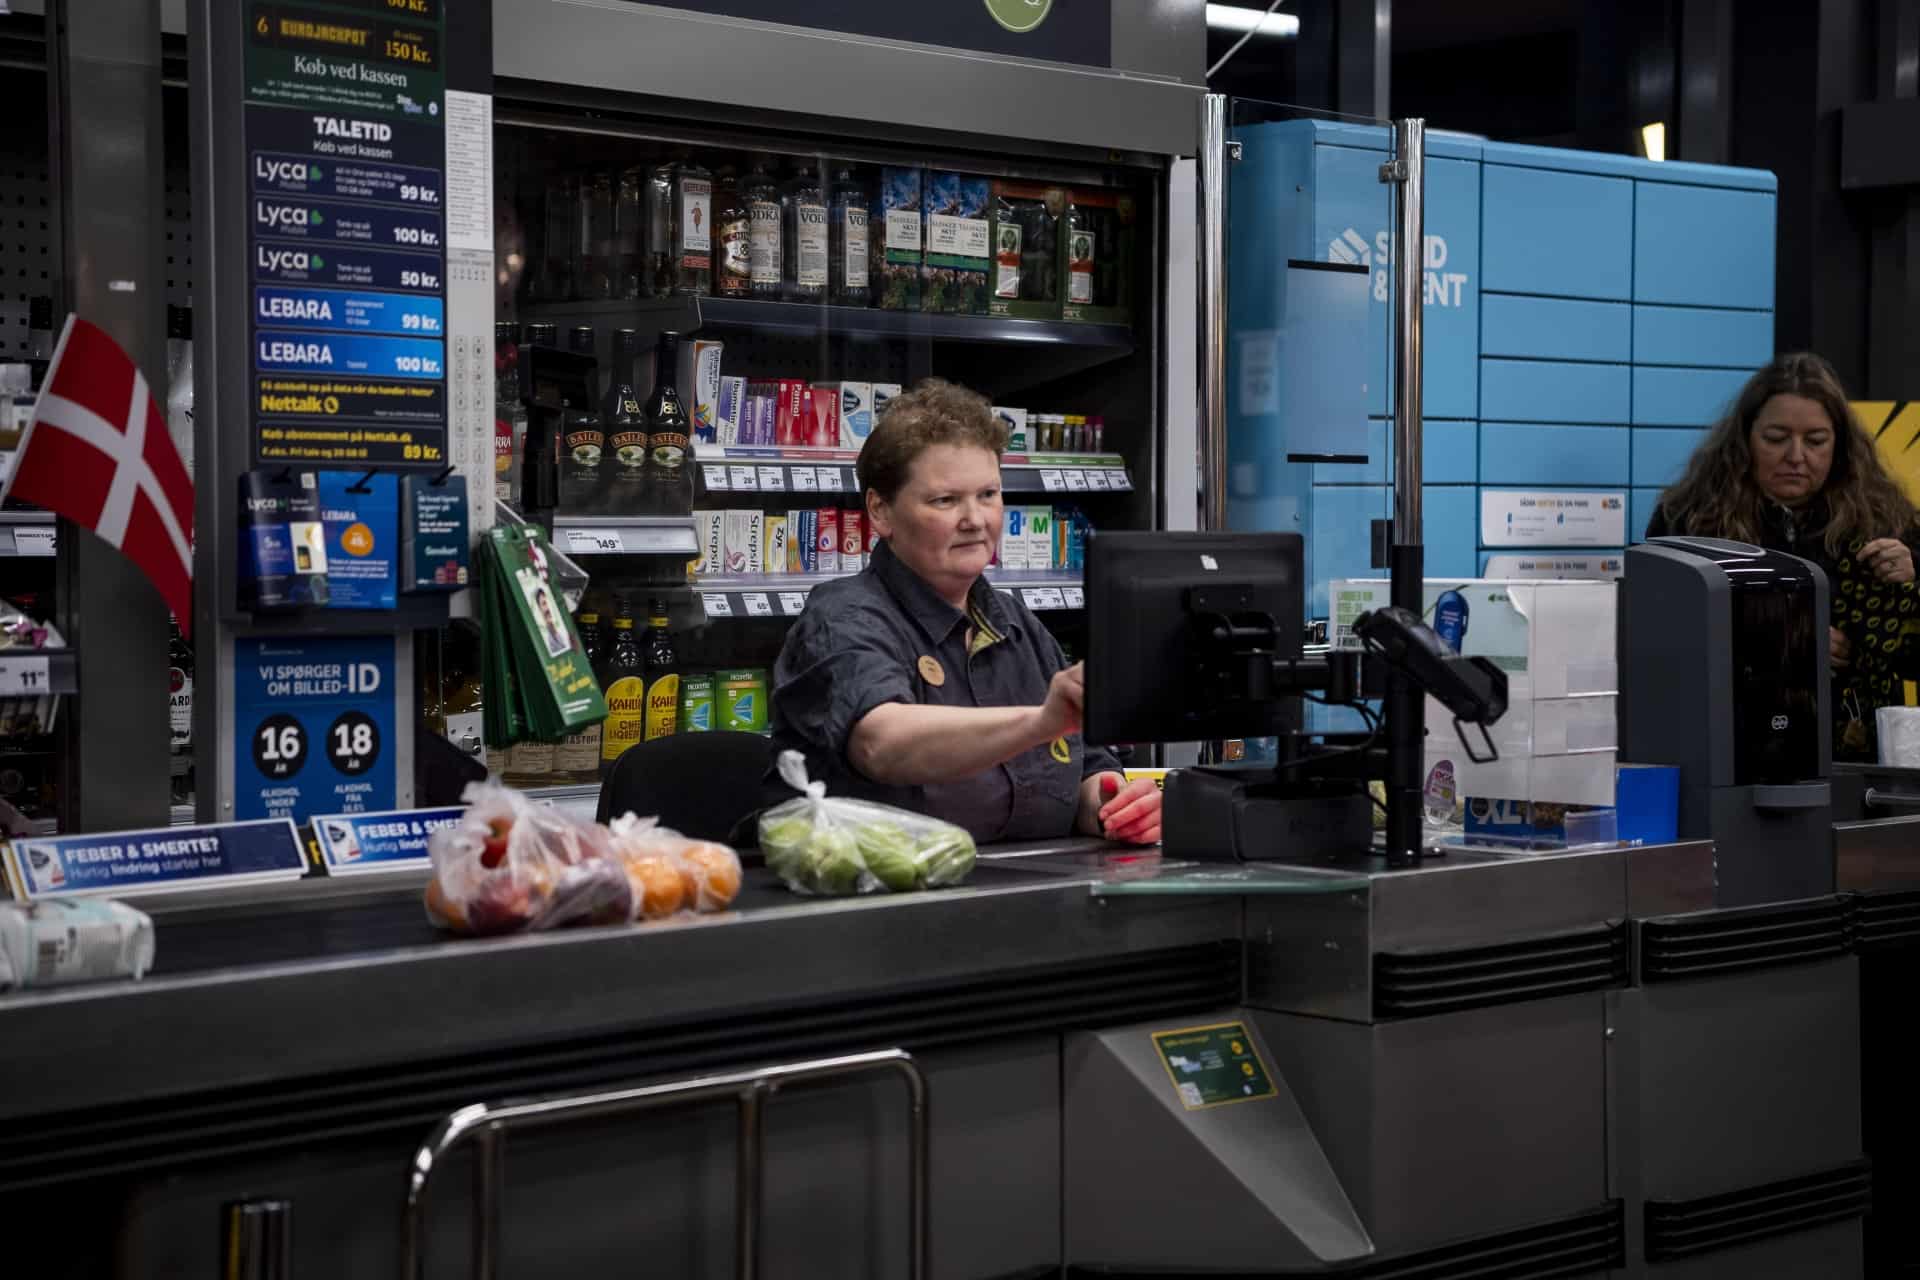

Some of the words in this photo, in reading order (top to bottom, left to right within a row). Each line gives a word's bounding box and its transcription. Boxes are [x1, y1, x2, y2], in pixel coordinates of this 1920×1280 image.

[257, 17, 269, 33] 6
[385, 40, 410, 59] 150
[412, 44, 431, 63] kr.
[294, 56, 327, 76] Køb
[329, 59, 357, 80] ved
[360, 63, 408, 88] kassen
[313, 117, 393, 141] TALETID
[313, 140, 335, 153] Køb
[336, 142, 358, 155] ved
[359, 144, 393, 159] kassen
[255, 156, 308, 184] Lyca
[400, 185, 418, 200] 99
[420, 187, 439, 203] kr.
[257, 202, 309, 229] Lyca
[750, 208, 779, 221] ODKA
[393, 227, 418, 243] 100
[420, 229, 440, 246] kr.
[258, 247, 309, 272] Lyca
[1375, 231, 1448, 269] SD
[401, 271, 419, 287] 50
[421, 271, 440, 288] kr.
[259, 297, 332, 320] LEBARA
[402, 314, 420, 329] 99
[422, 314, 440, 331] kr.
[260, 342, 334, 365] LEBARA
[394, 357, 420, 372] 100
[422, 357, 441, 374] kr.
[261, 395, 323, 413] Nettalk
[792, 383, 802, 417] Pamol
[422, 444, 441, 460] kr.
[259, 665, 274, 680] VI
[276, 663, 342, 680] SPØRGER
[267, 681, 291, 697] OM
[348, 663, 381, 694] ID
[261, 725, 301, 760] 16
[334, 723, 373, 757] 18
[260, 786, 301, 799] ALKOHOL
[334, 782, 373, 795] ALKOHOL
[265, 796, 296, 808] UNDER
[344, 793, 363, 804] FRA
[358, 822, 410, 839] FEBER
[411, 820, 423, 835] &
[65, 844, 125, 865] FEBER
[127, 843, 141, 860] &
[143, 836, 220, 858] SMERTE?
[363, 839, 398, 853] Hurtig
[69, 864, 110, 880] Hurtig
[111, 860, 160, 877] lindring
[162, 857, 200, 872] starter
[202, 855, 222, 868] her
